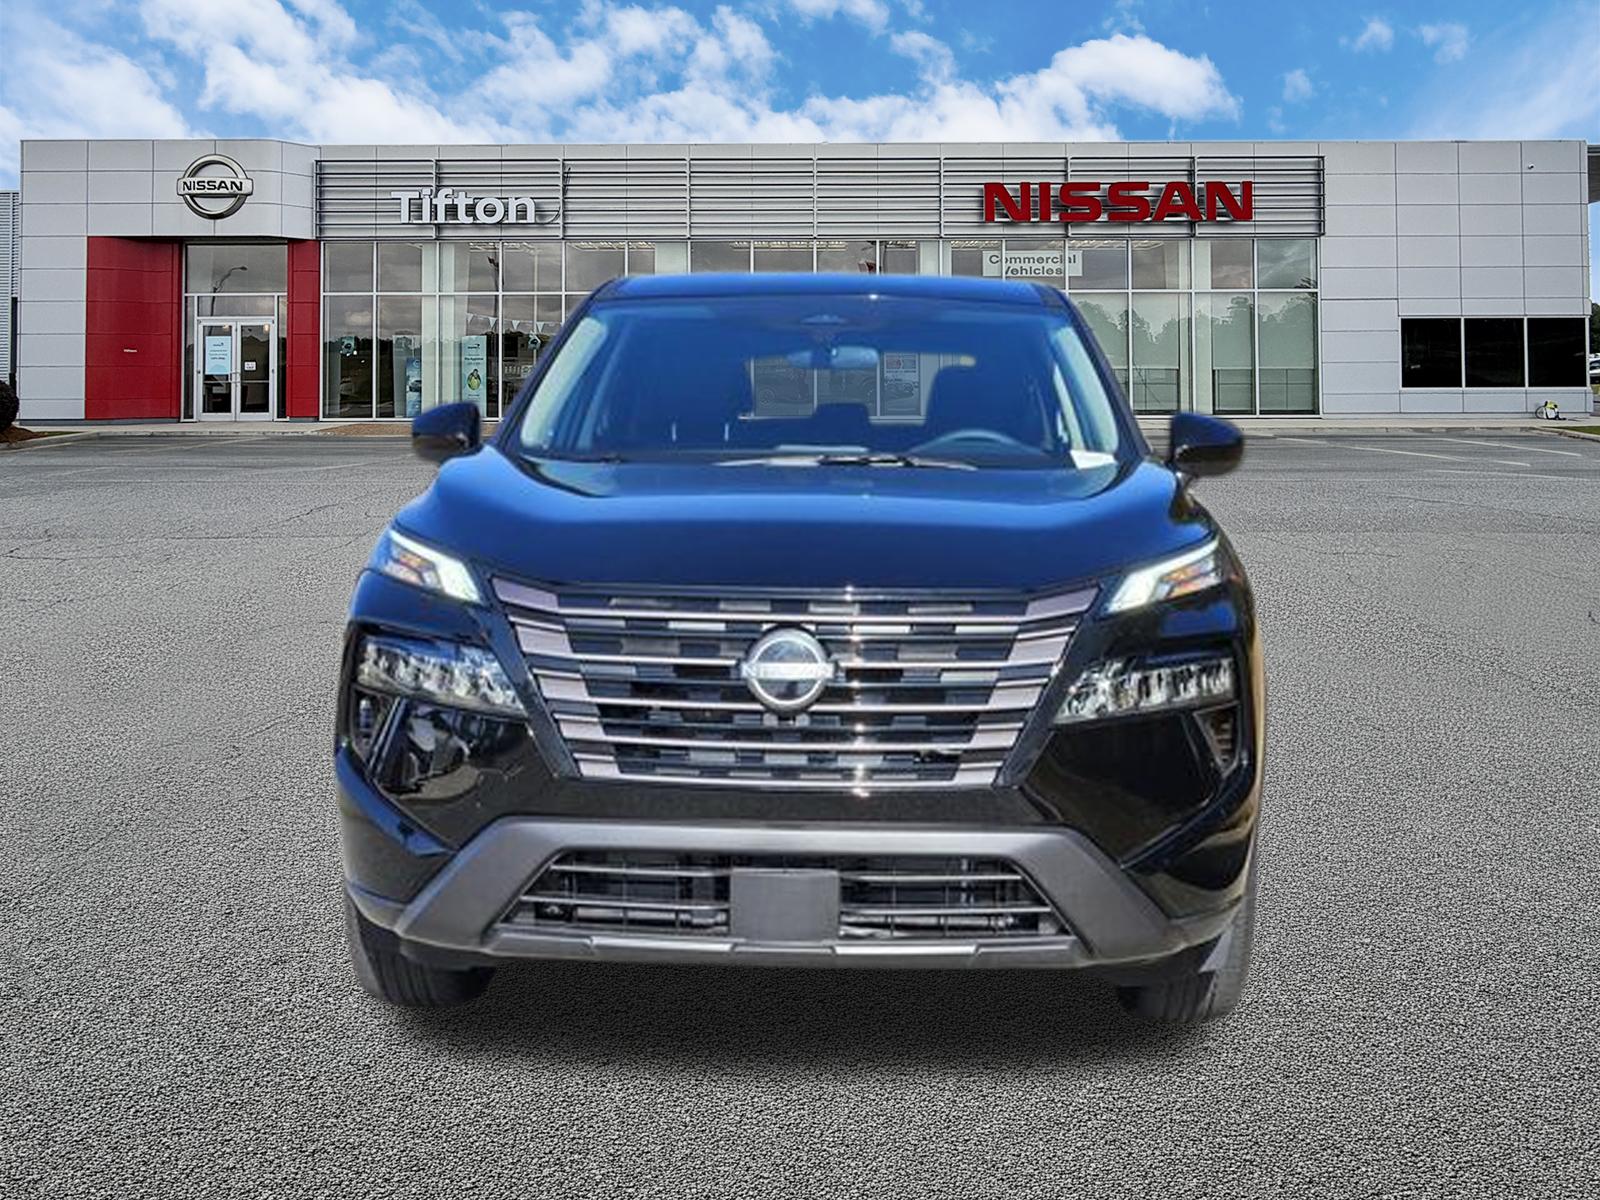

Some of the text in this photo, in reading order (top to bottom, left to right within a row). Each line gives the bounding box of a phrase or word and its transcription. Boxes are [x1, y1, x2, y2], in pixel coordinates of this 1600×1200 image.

[182, 180, 243, 191] NISSAN
[983, 180, 1253, 222] NISSAN
[390, 187, 536, 224] Tifton
